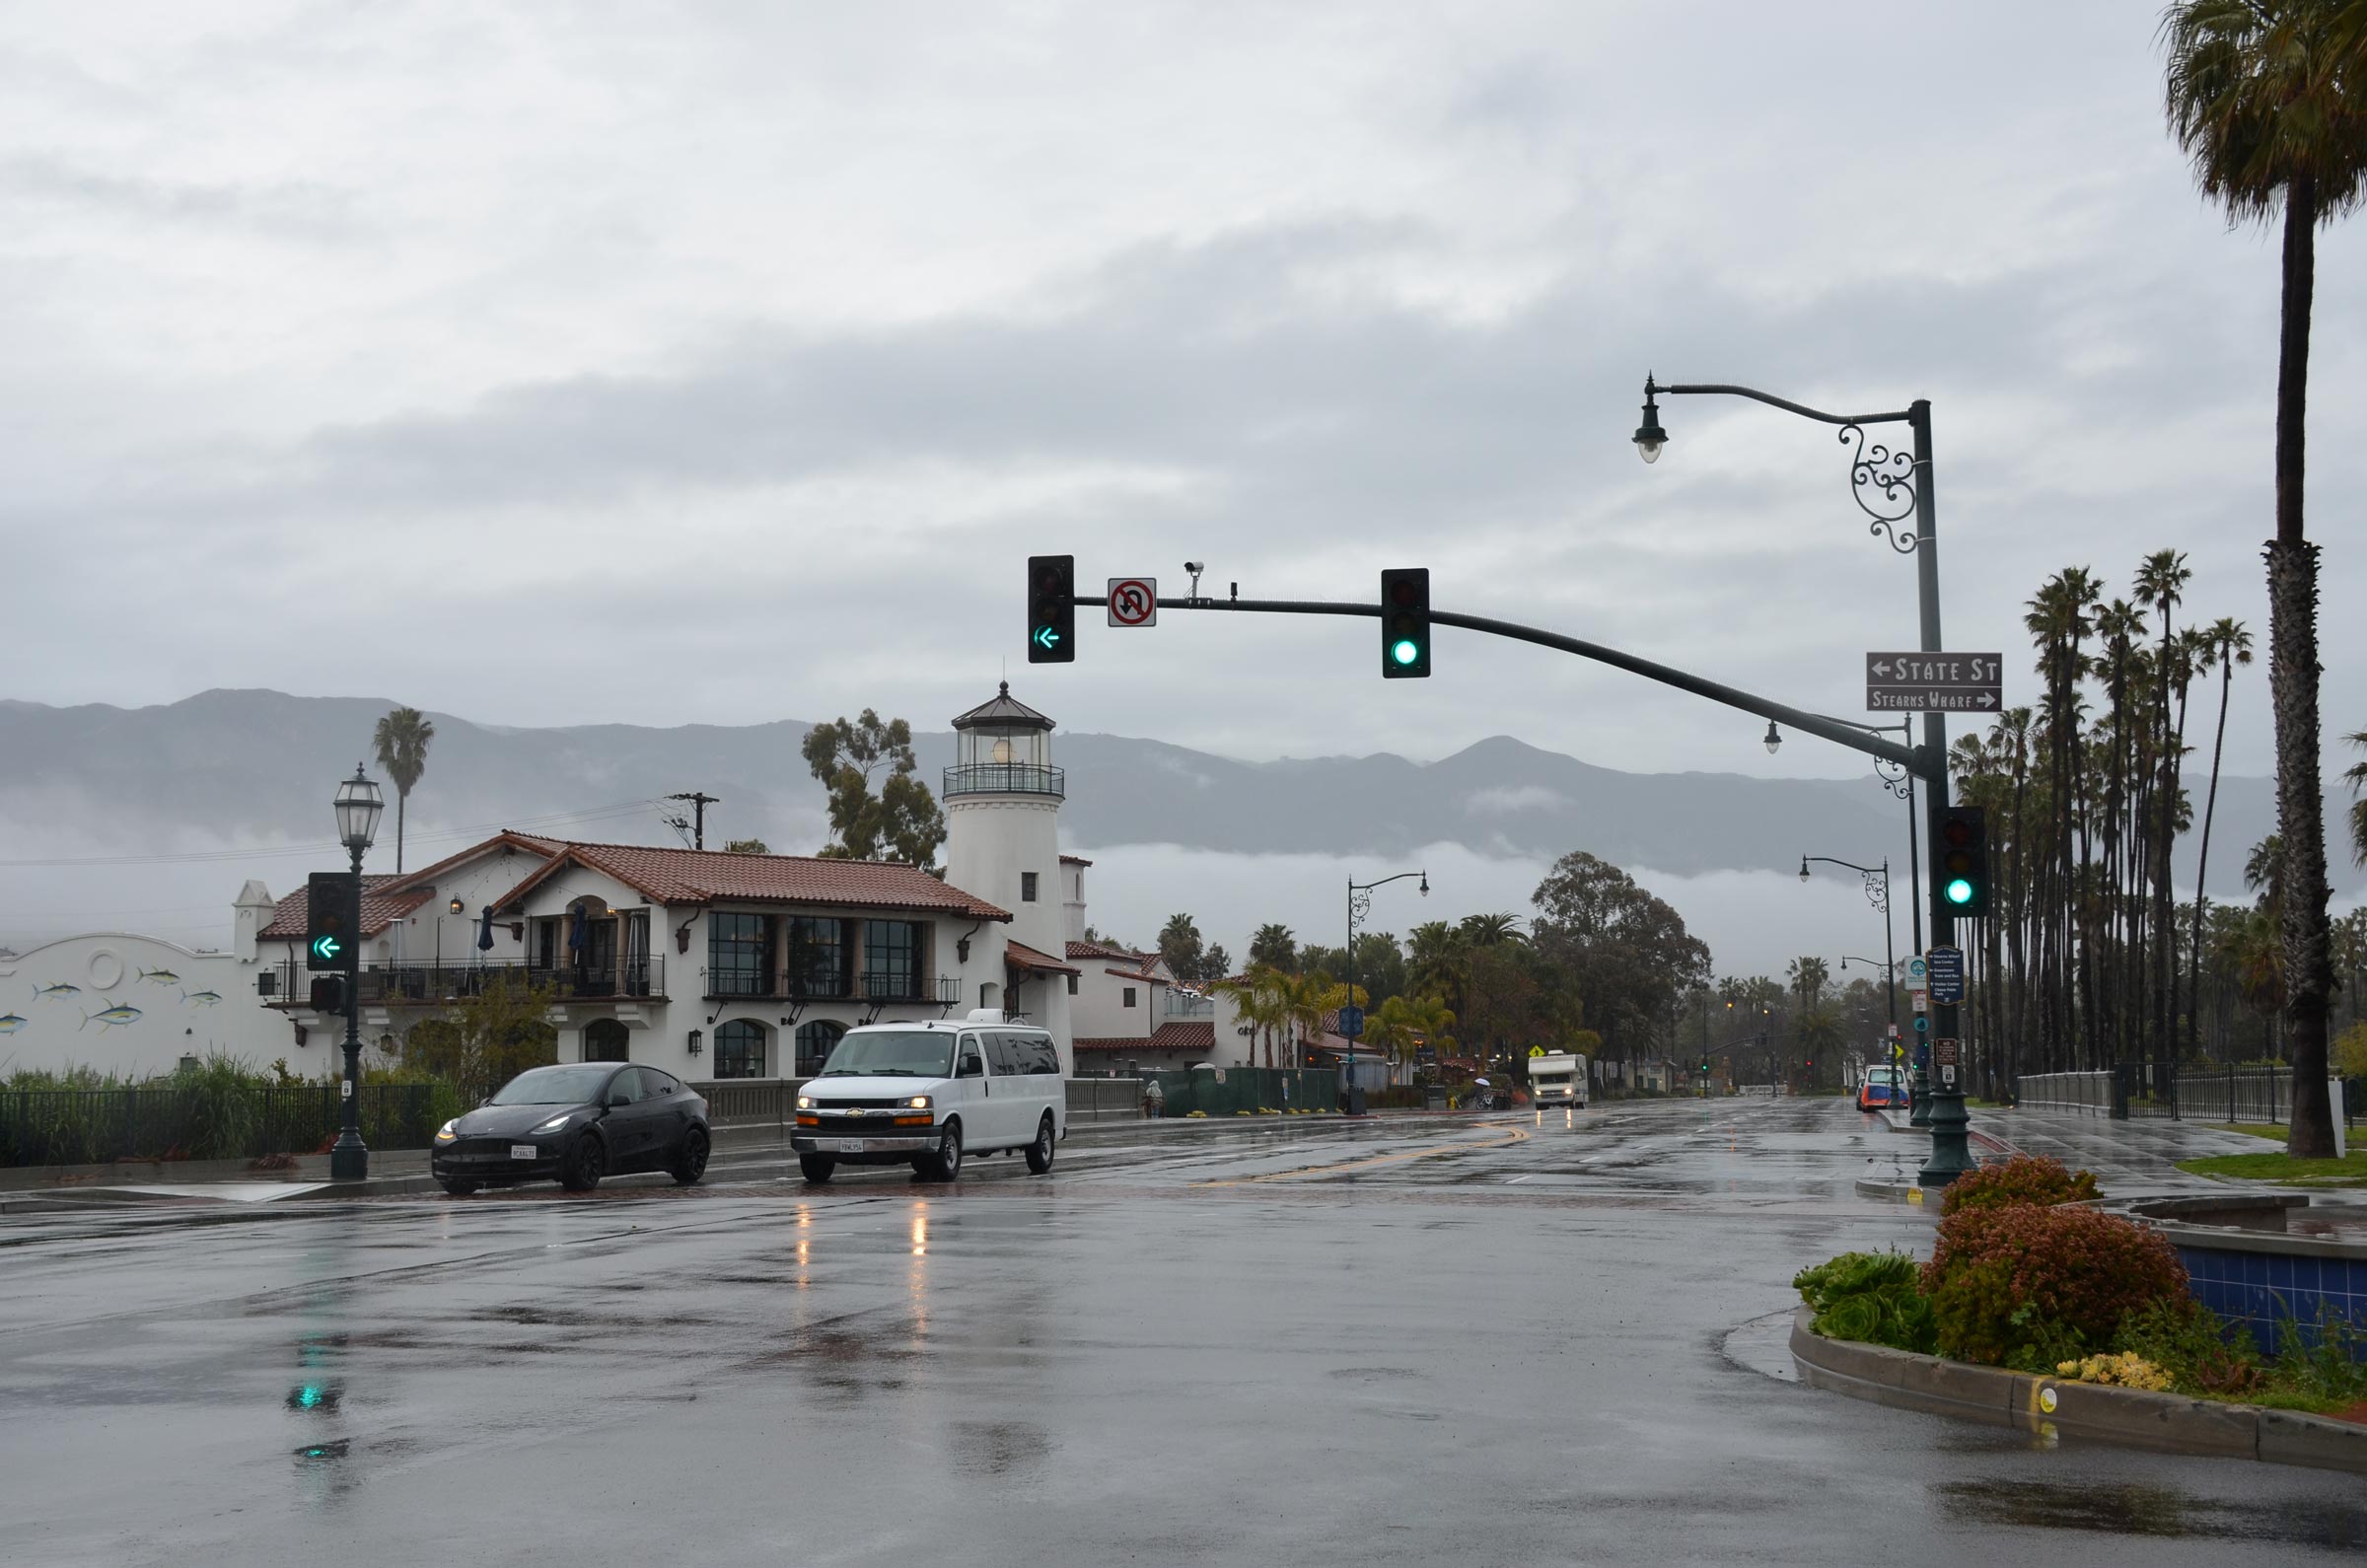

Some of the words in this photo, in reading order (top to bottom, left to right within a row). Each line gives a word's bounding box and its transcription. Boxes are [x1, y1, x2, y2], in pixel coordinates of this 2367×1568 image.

[1896, 658, 1959, 680] STATE
[1971, 658, 1997, 681] ST
[1873, 690, 1924, 707] STEARNS
[1929, 691, 1972, 708] WHARF
